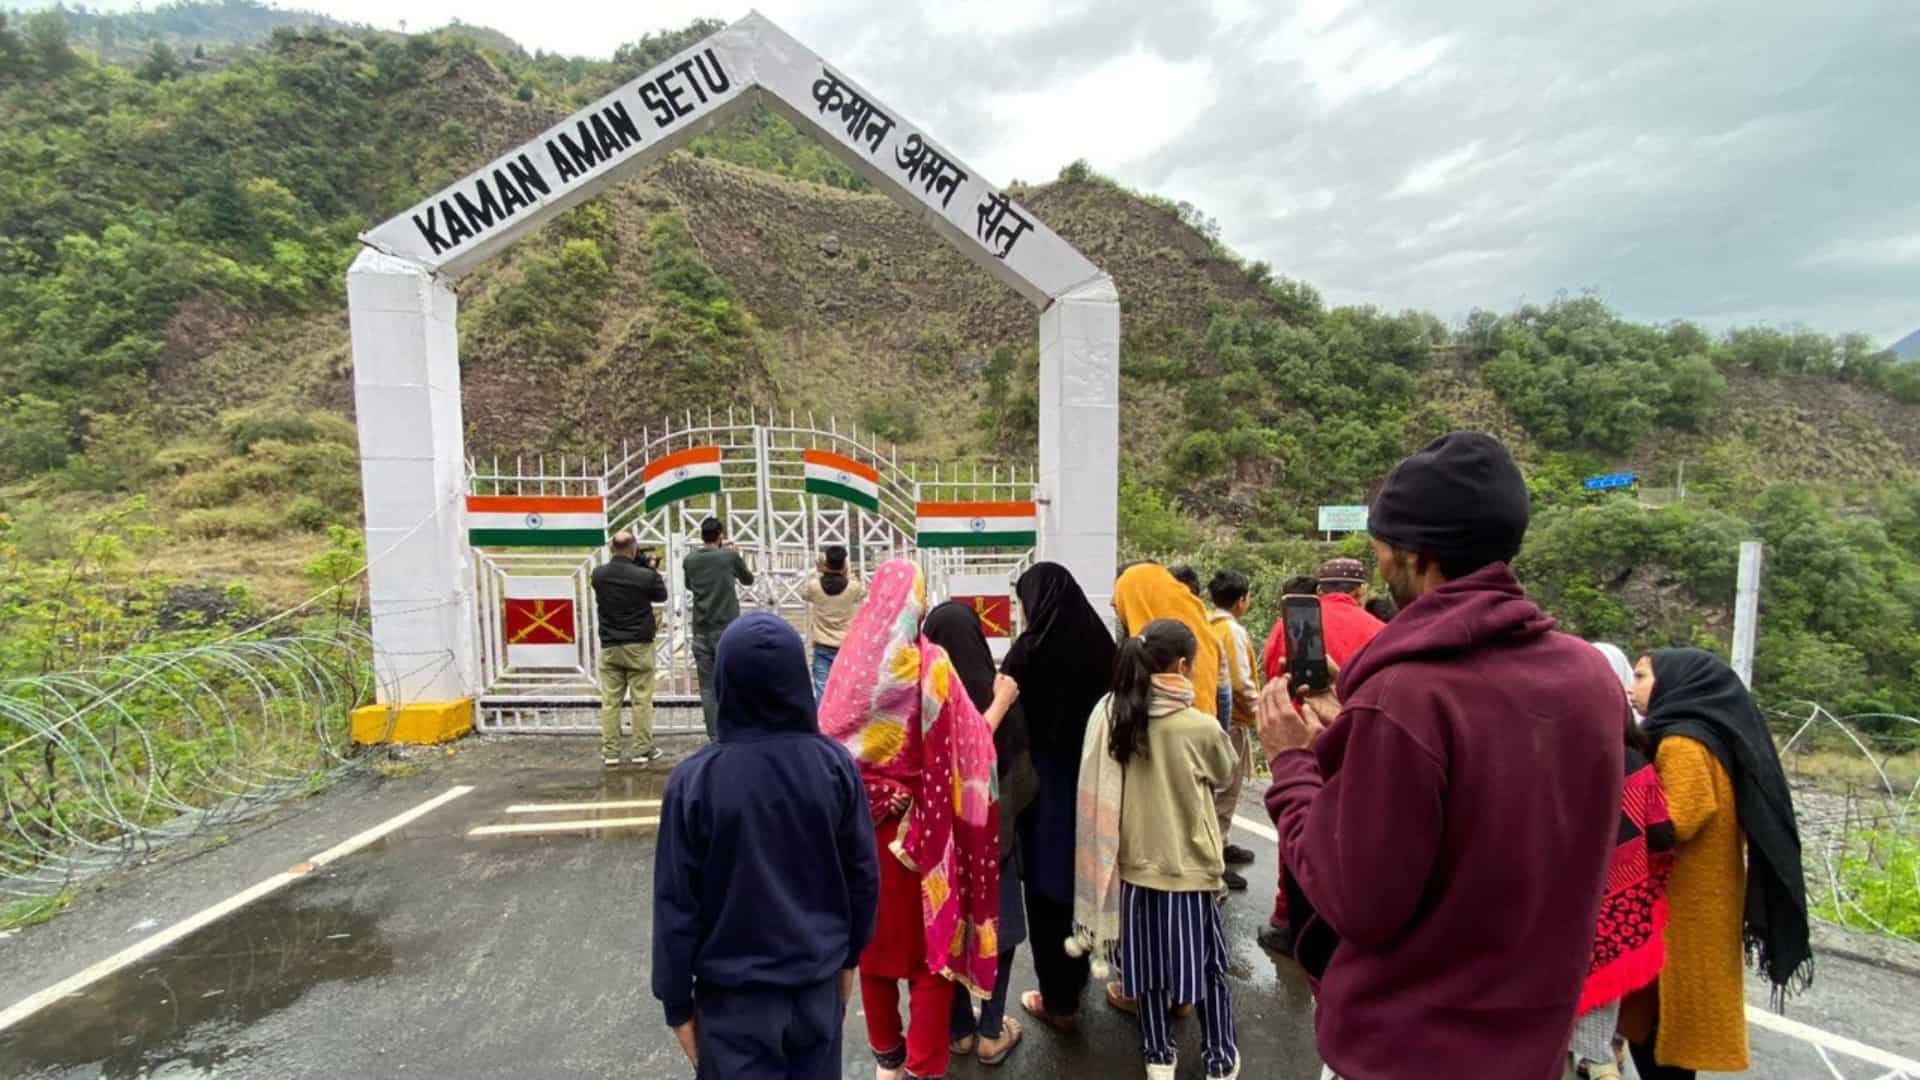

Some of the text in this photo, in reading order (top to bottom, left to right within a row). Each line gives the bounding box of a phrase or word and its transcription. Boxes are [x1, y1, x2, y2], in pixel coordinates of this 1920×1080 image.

[413, 48, 730, 255] KAMAN AMAN SETU
[812, 68, 896, 154] कमान
[896, 133, 968, 208] अमन
